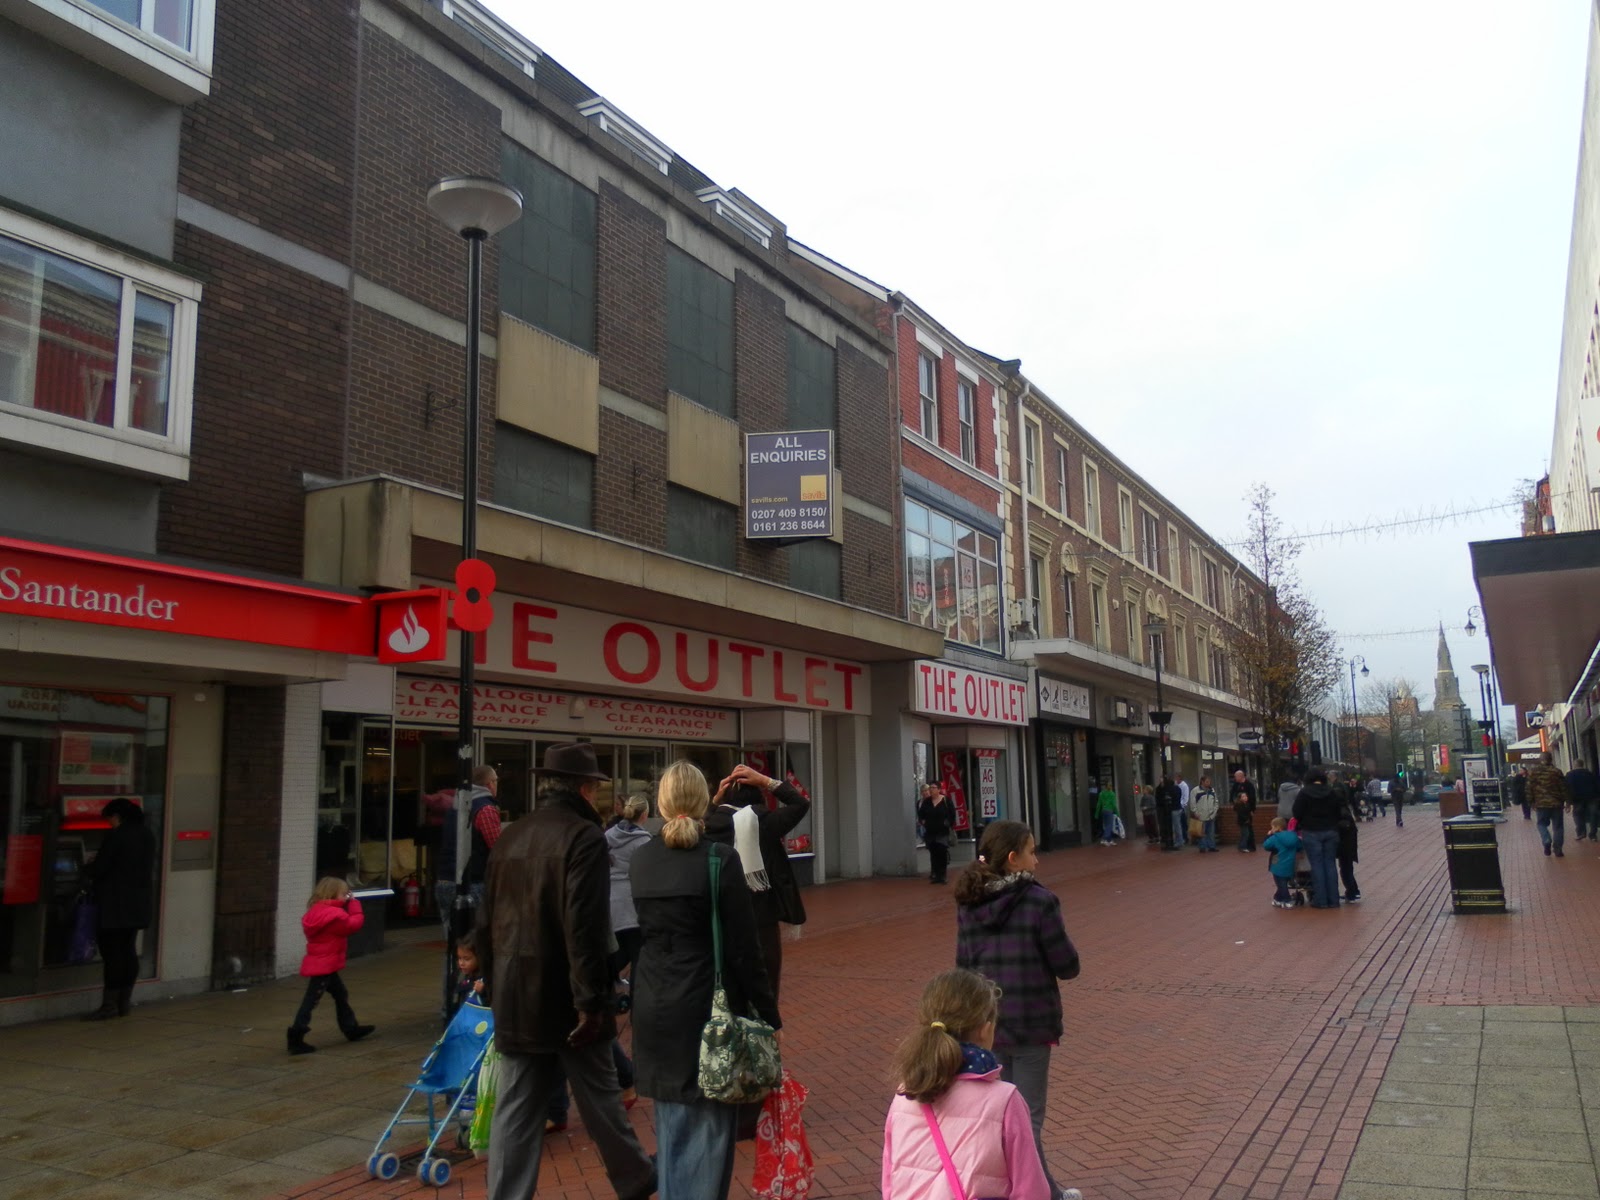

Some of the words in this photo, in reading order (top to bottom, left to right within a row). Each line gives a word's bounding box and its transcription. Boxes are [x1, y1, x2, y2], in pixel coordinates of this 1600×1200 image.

[775, 437, 802, 448] ALL
[750, 449, 827, 464] ENQUIRIES
[751, 496, 789, 504] savills.com
[751, 509, 776, 519] 0207
[778, 508, 797, 518] 409
[753, 521, 777, 532] 0161
[780, 521, 799, 531] 236
[801, 520, 826, 530] 8644
[0, 567, 180, 622] Santander
[602, 620, 863, 710] OUTLET
[920, 664, 958, 713] THE
[964, 673, 1026, 723] OUTLET
[399, 709, 427, 717] UP
[435, 711, 459, 720] TO
[508, 717, 540, 726] OFF
[588, 698, 613, 710] EX
[620, 702, 727, 721] CATALOGUE
[605, 712, 713, 730] CLEARANCE
[657, 728, 683, 736] 50%
[685, 730, 708, 738] OFF
[982, 768, 993, 783] AG
[943, 753, 967, 828] SALE
[984, 799, 996, 815] £5
